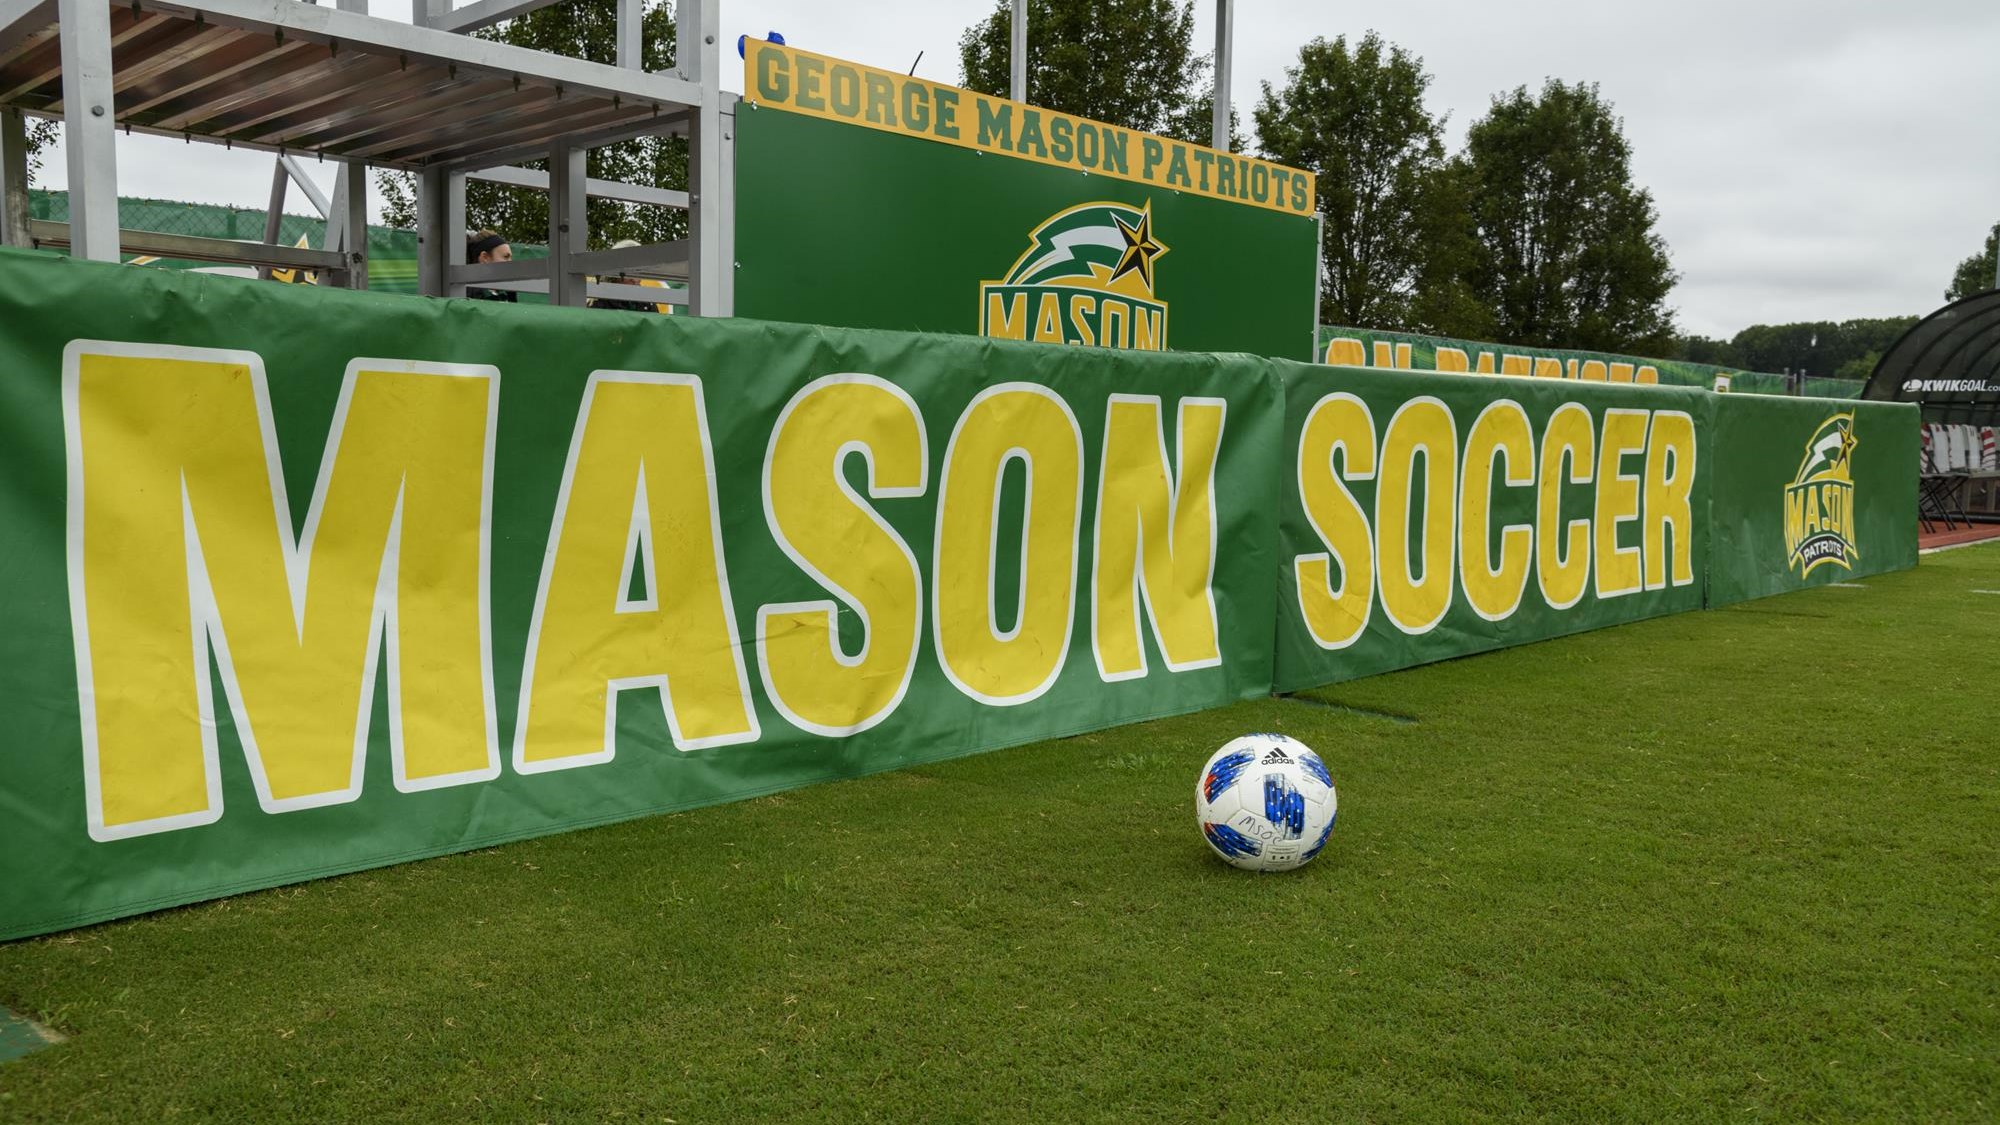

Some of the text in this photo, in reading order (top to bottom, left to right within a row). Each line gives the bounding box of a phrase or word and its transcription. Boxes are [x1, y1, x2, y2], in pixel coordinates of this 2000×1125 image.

[756, 45, 1310, 212] GEORGE MASON PATRIOTS
[988, 292, 1161, 351] MASON
[1921, 379, 2000, 393] KWIKGOAL.co
[1787, 484, 1854, 557] MASON
[1803, 540, 1842, 562] PATROTS
[62, 338, 1697, 843] MASON SOCCER
[1261, 757, 1295, 766] adidas
